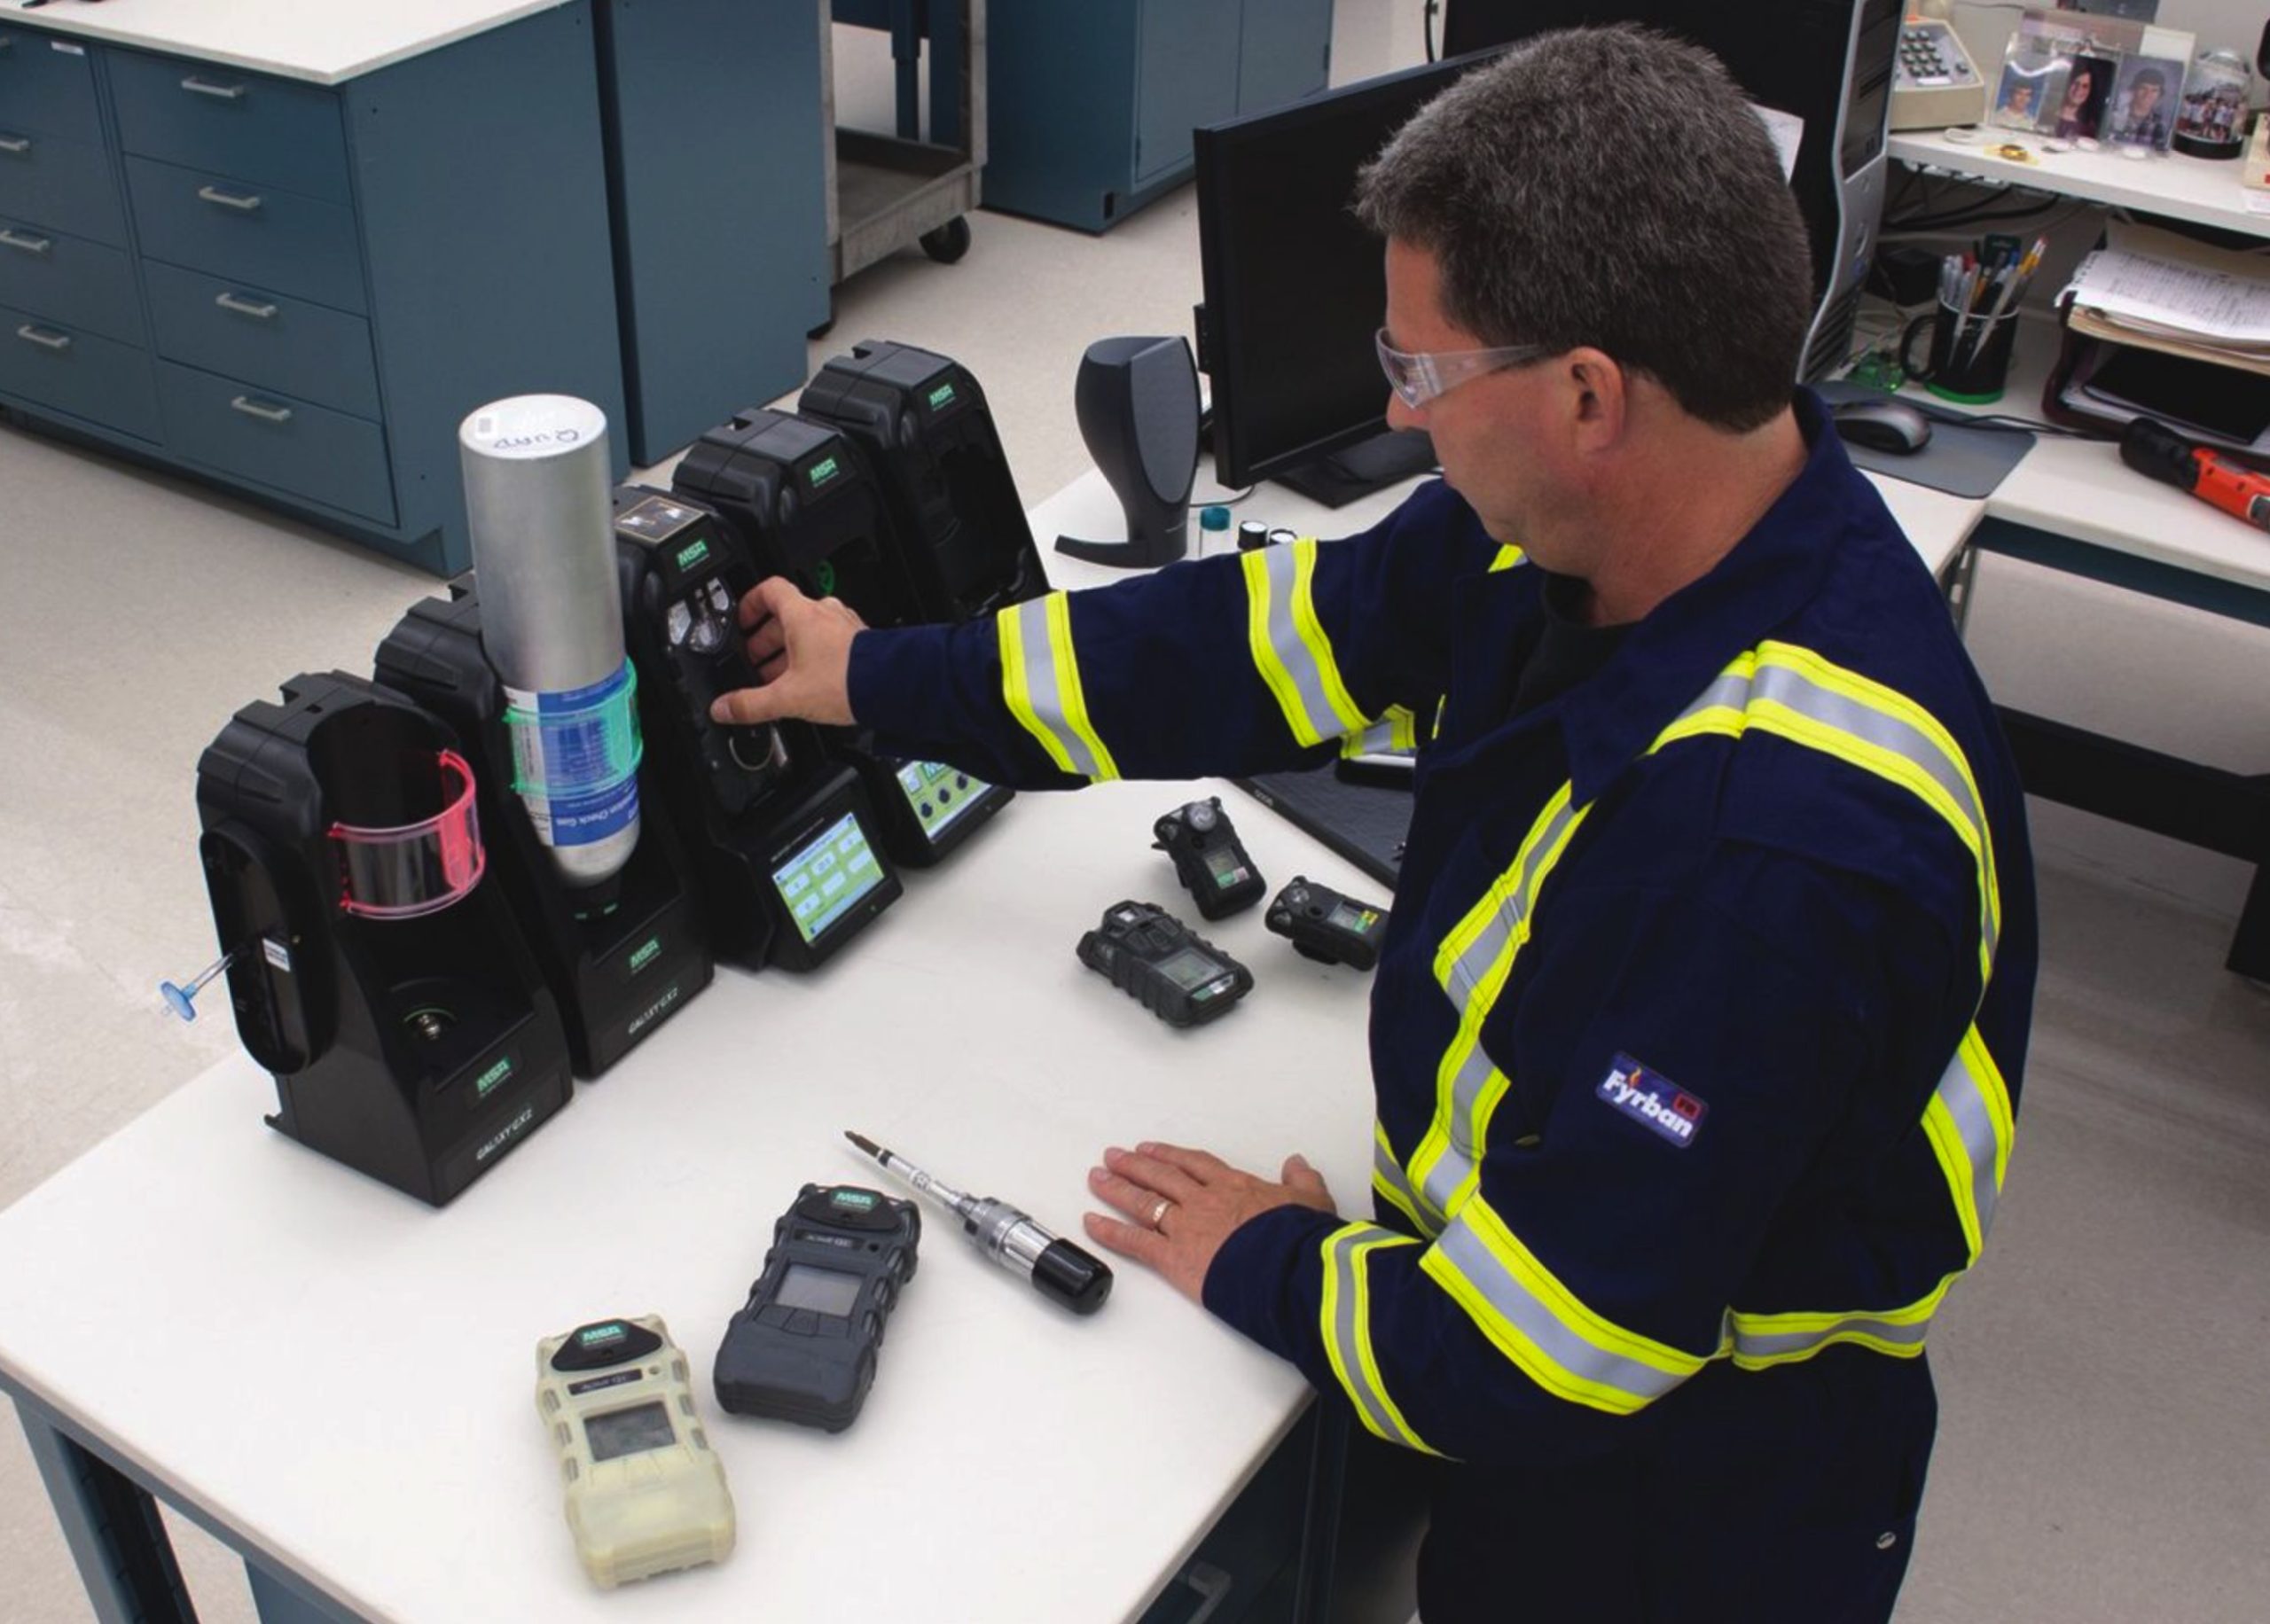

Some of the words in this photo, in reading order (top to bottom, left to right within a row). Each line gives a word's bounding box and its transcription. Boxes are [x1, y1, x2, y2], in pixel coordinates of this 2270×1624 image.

[677, 539, 708, 566] MSA
[578, 808, 609, 825] Check
[630, 938, 659, 968] MSA
[477, 1059, 510, 1092] MSA
[1603, 1068, 1694, 1137] Fyrban
[834, 1191, 873, 1206] MSA
